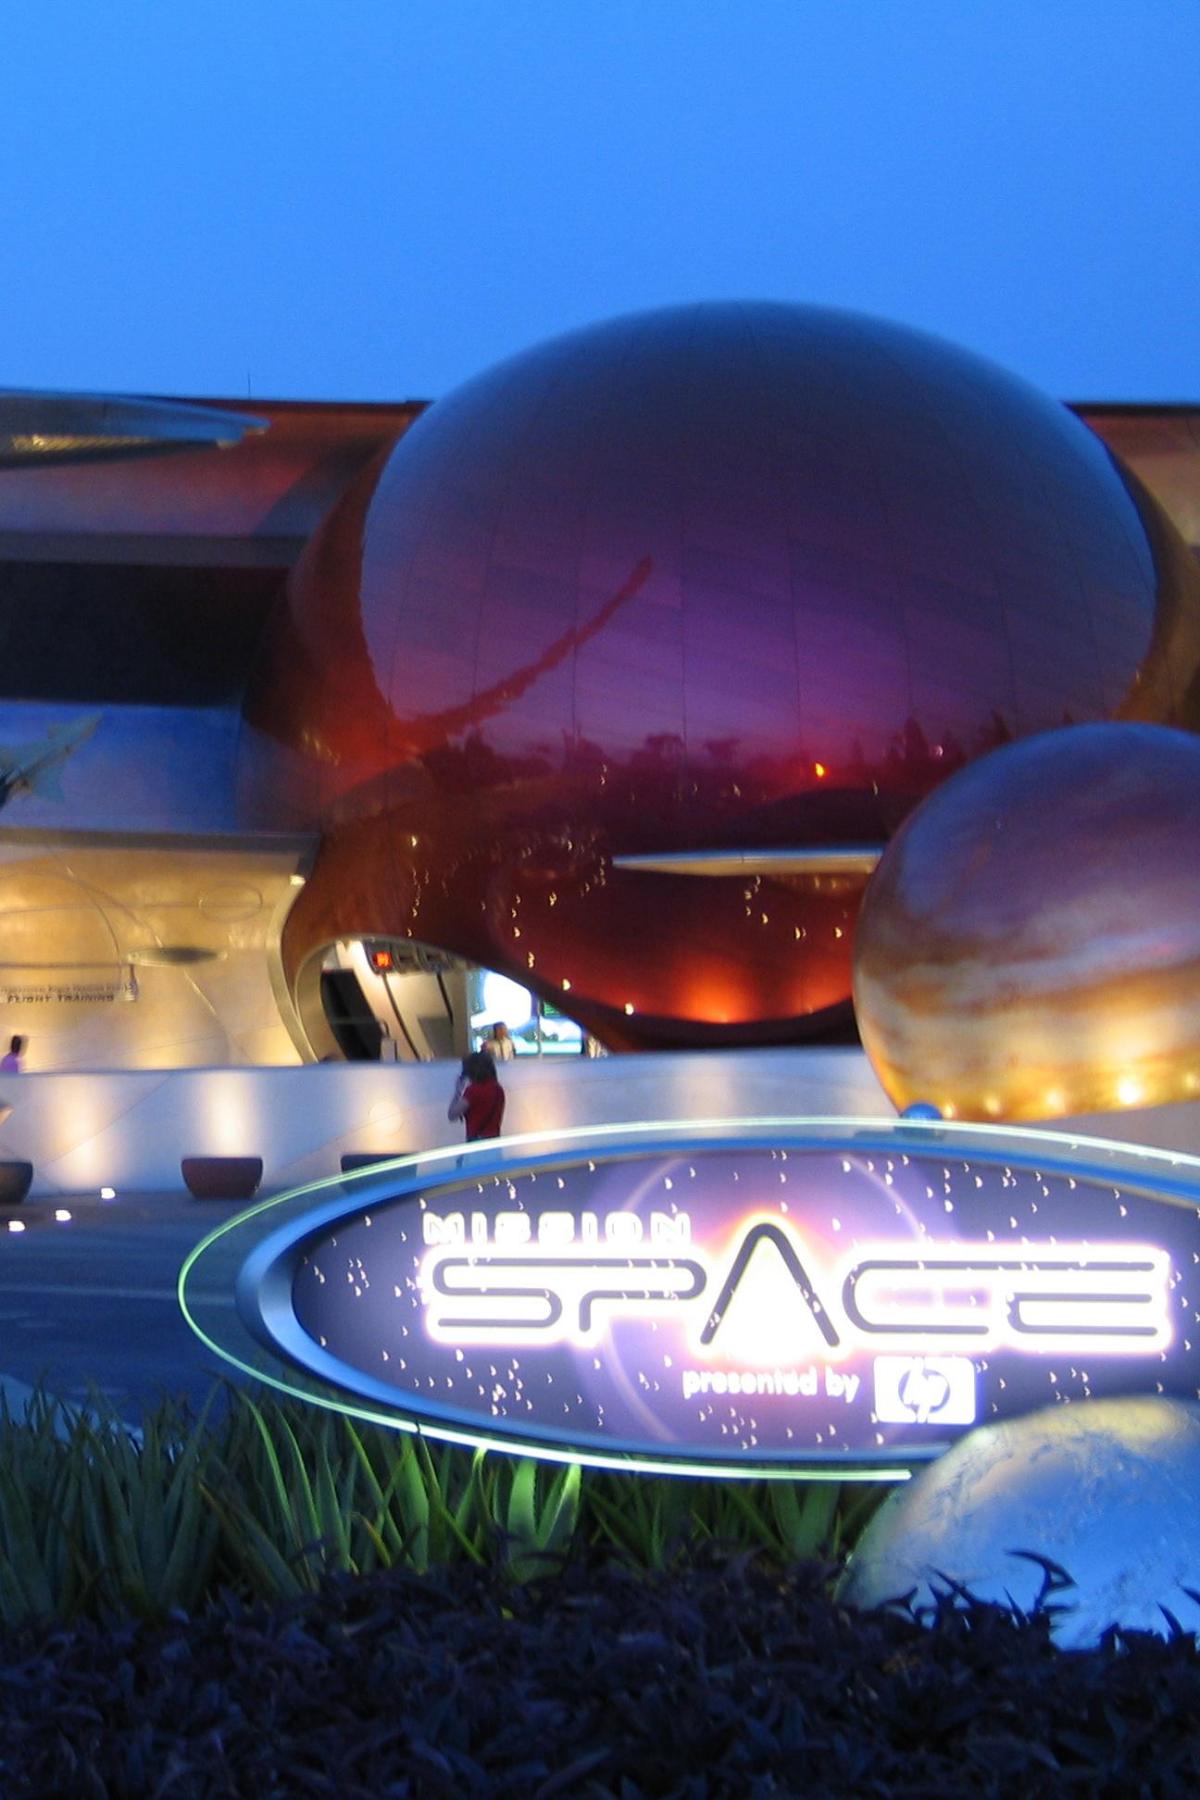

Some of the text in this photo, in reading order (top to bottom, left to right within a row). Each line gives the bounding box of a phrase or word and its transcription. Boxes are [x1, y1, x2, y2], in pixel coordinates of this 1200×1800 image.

[422, 1211, 692, 1245] MISSION
[424, 1219, 1168, 1349] SPACE
[682, 1365, 860, 1403] presented by
[898, 1357, 951, 1424] hp
